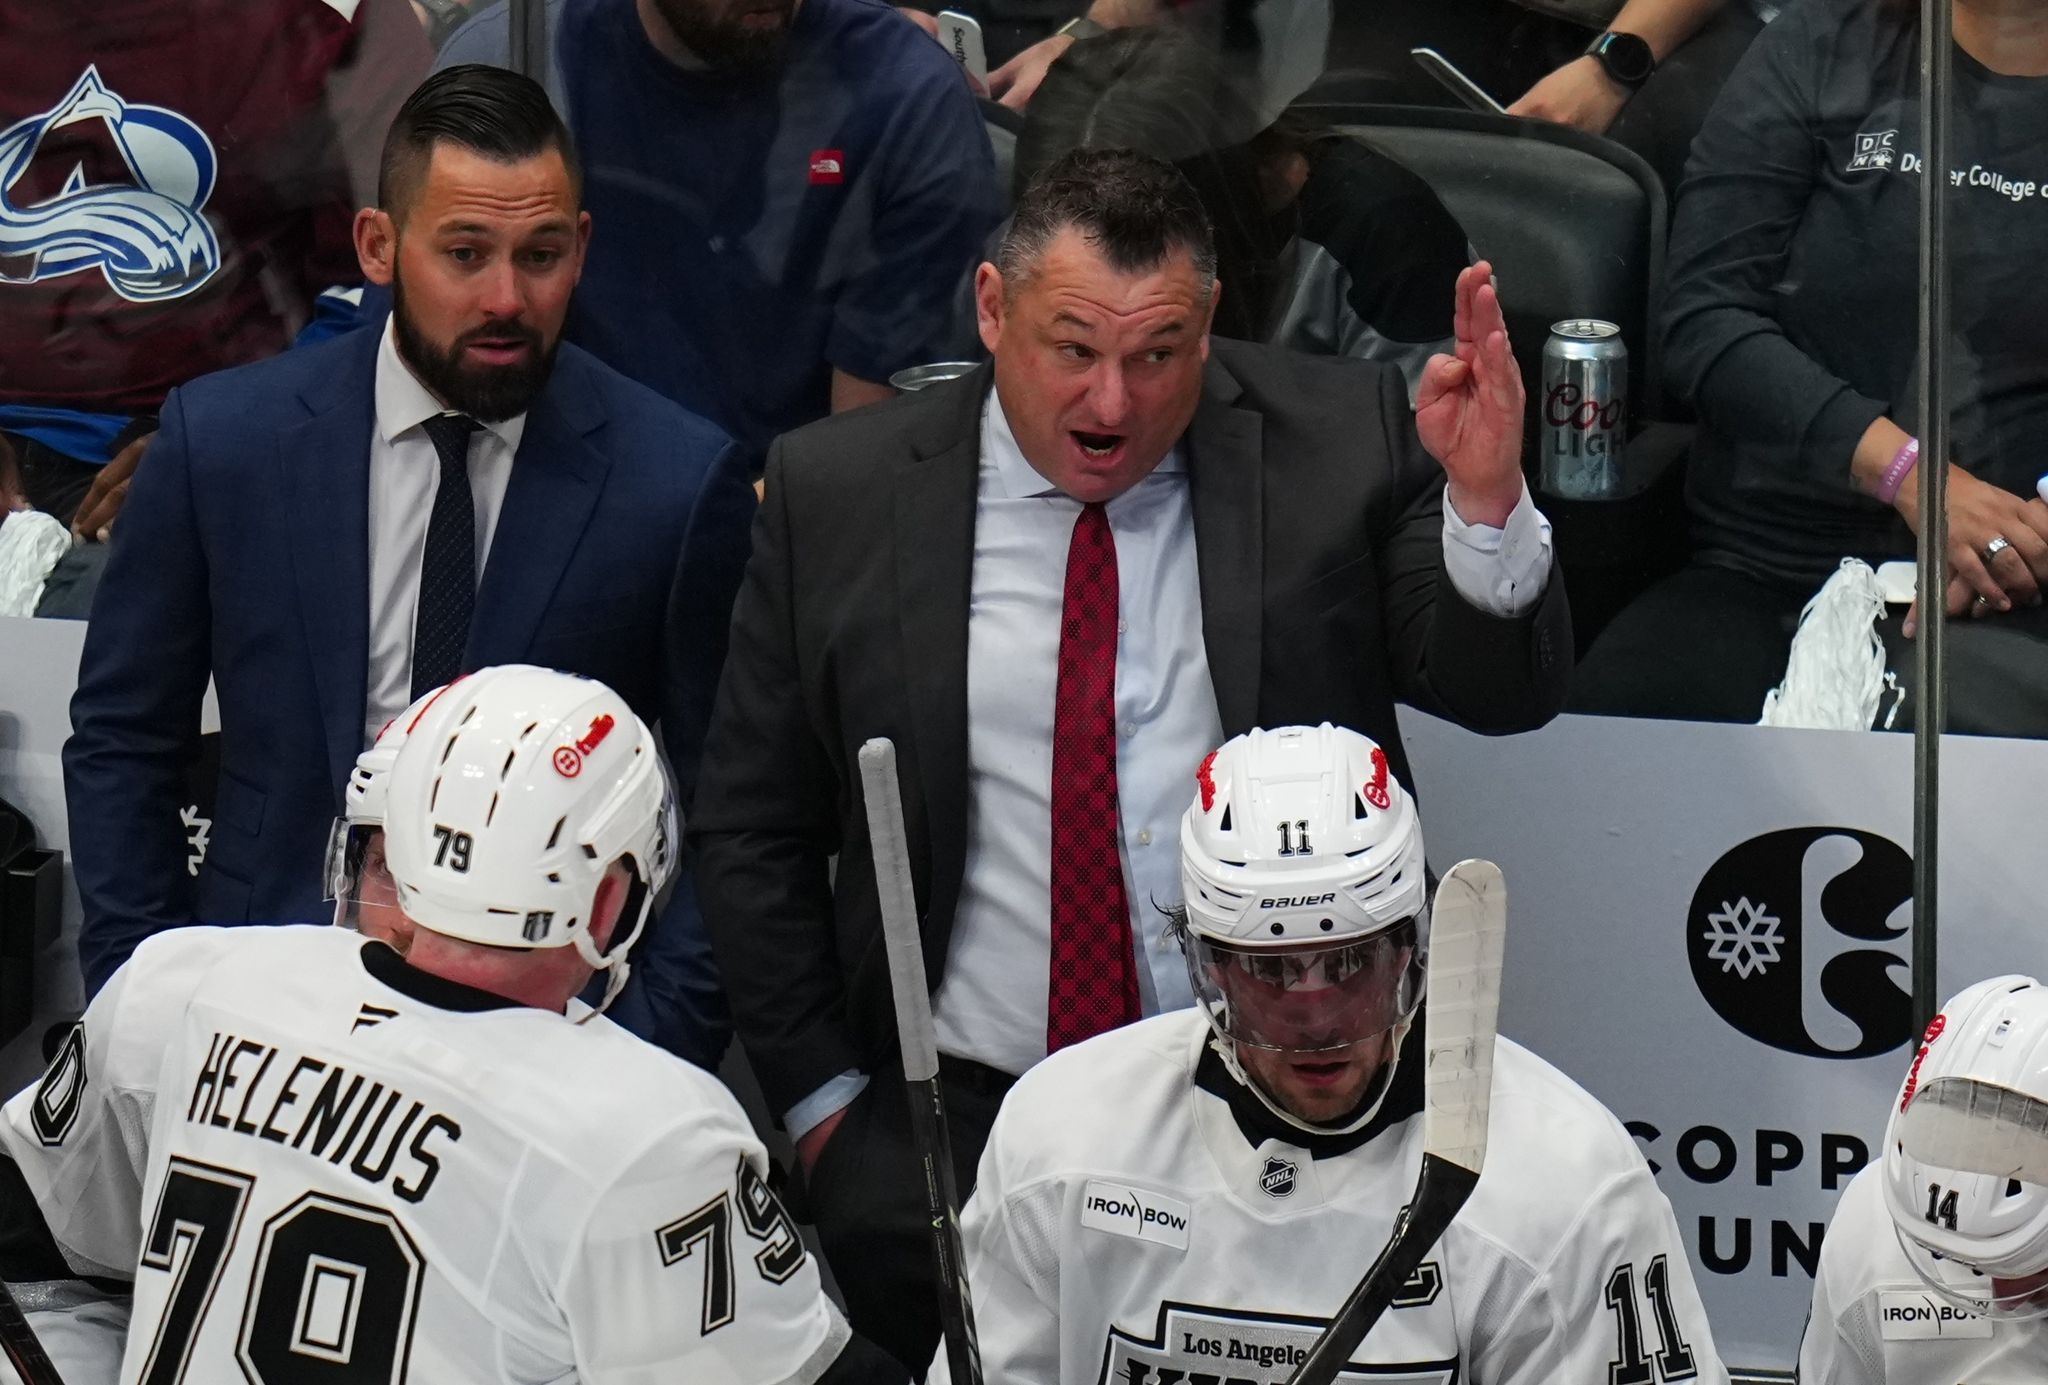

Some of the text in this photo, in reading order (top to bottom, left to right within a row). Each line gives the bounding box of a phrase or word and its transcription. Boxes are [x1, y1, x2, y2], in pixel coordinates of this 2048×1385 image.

[1900, 153, 1966, 187] Deer
[1969, 165, 2035, 201] College
[433, 823, 474, 874] 79
[1277, 820, 1314, 858] 11
[187, 1032, 462, 1204] HELENIUS
[1265, 1168, 1292, 1189] NHL
[1087, 1196, 1187, 1231] IRON BOW
[1925, 1182, 1959, 1231] 14
[655, 1149, 807, 1337] 79
[1604, 1253, 1698, 1385] 11
[1883, 1307, 1931, 1321] IRON
[1183, 1332, 1223, 1358] Los
